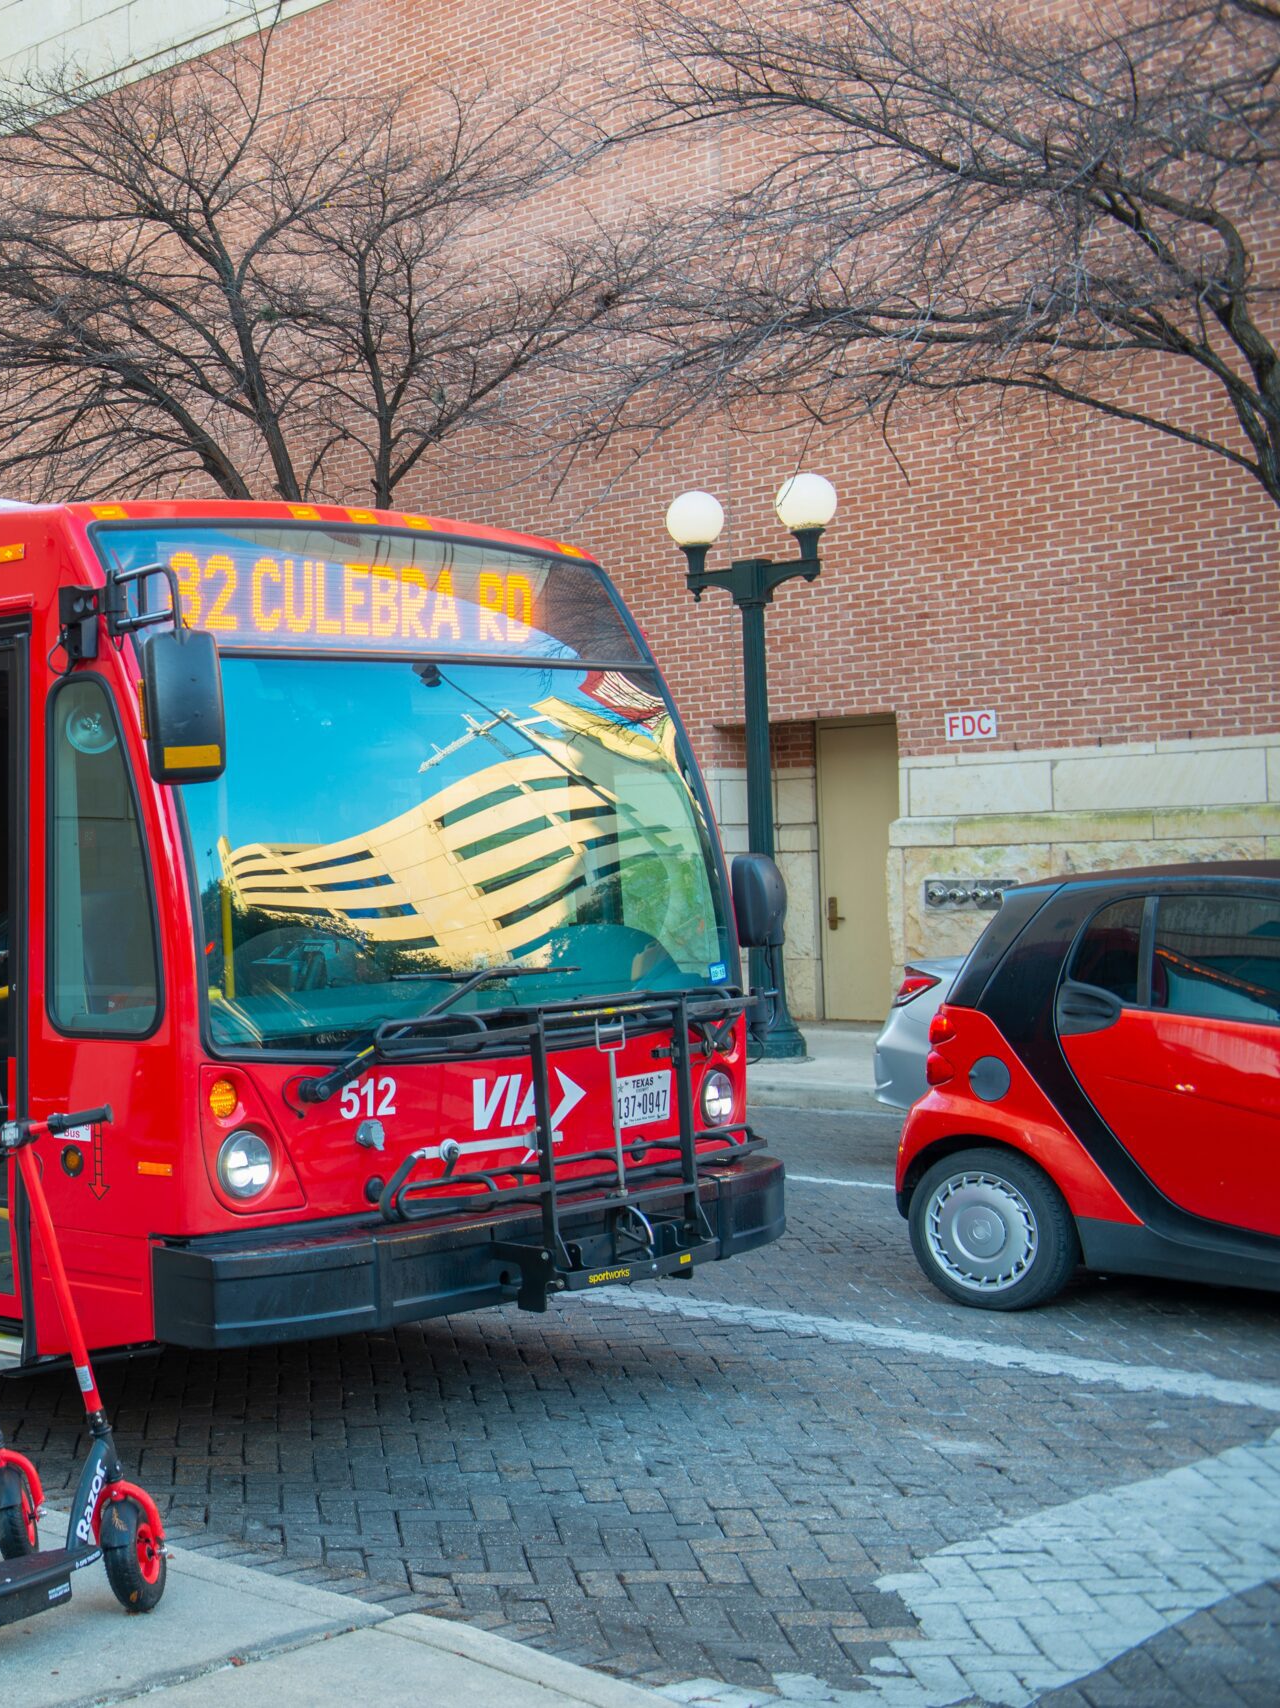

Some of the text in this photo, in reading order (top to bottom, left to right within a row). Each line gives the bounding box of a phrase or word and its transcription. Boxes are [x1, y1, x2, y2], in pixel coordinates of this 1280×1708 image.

[168, 551, 533, 642] 82 CULEBRA RD
[949, 713, 992, 737] FDC
[339, 1076, 397, 1119] 512
[632, 1077, 654, 1089] TEXAS
[588, 1267, 631, 1284] sportworks
[76, 1459, 107, 1541] Razor
